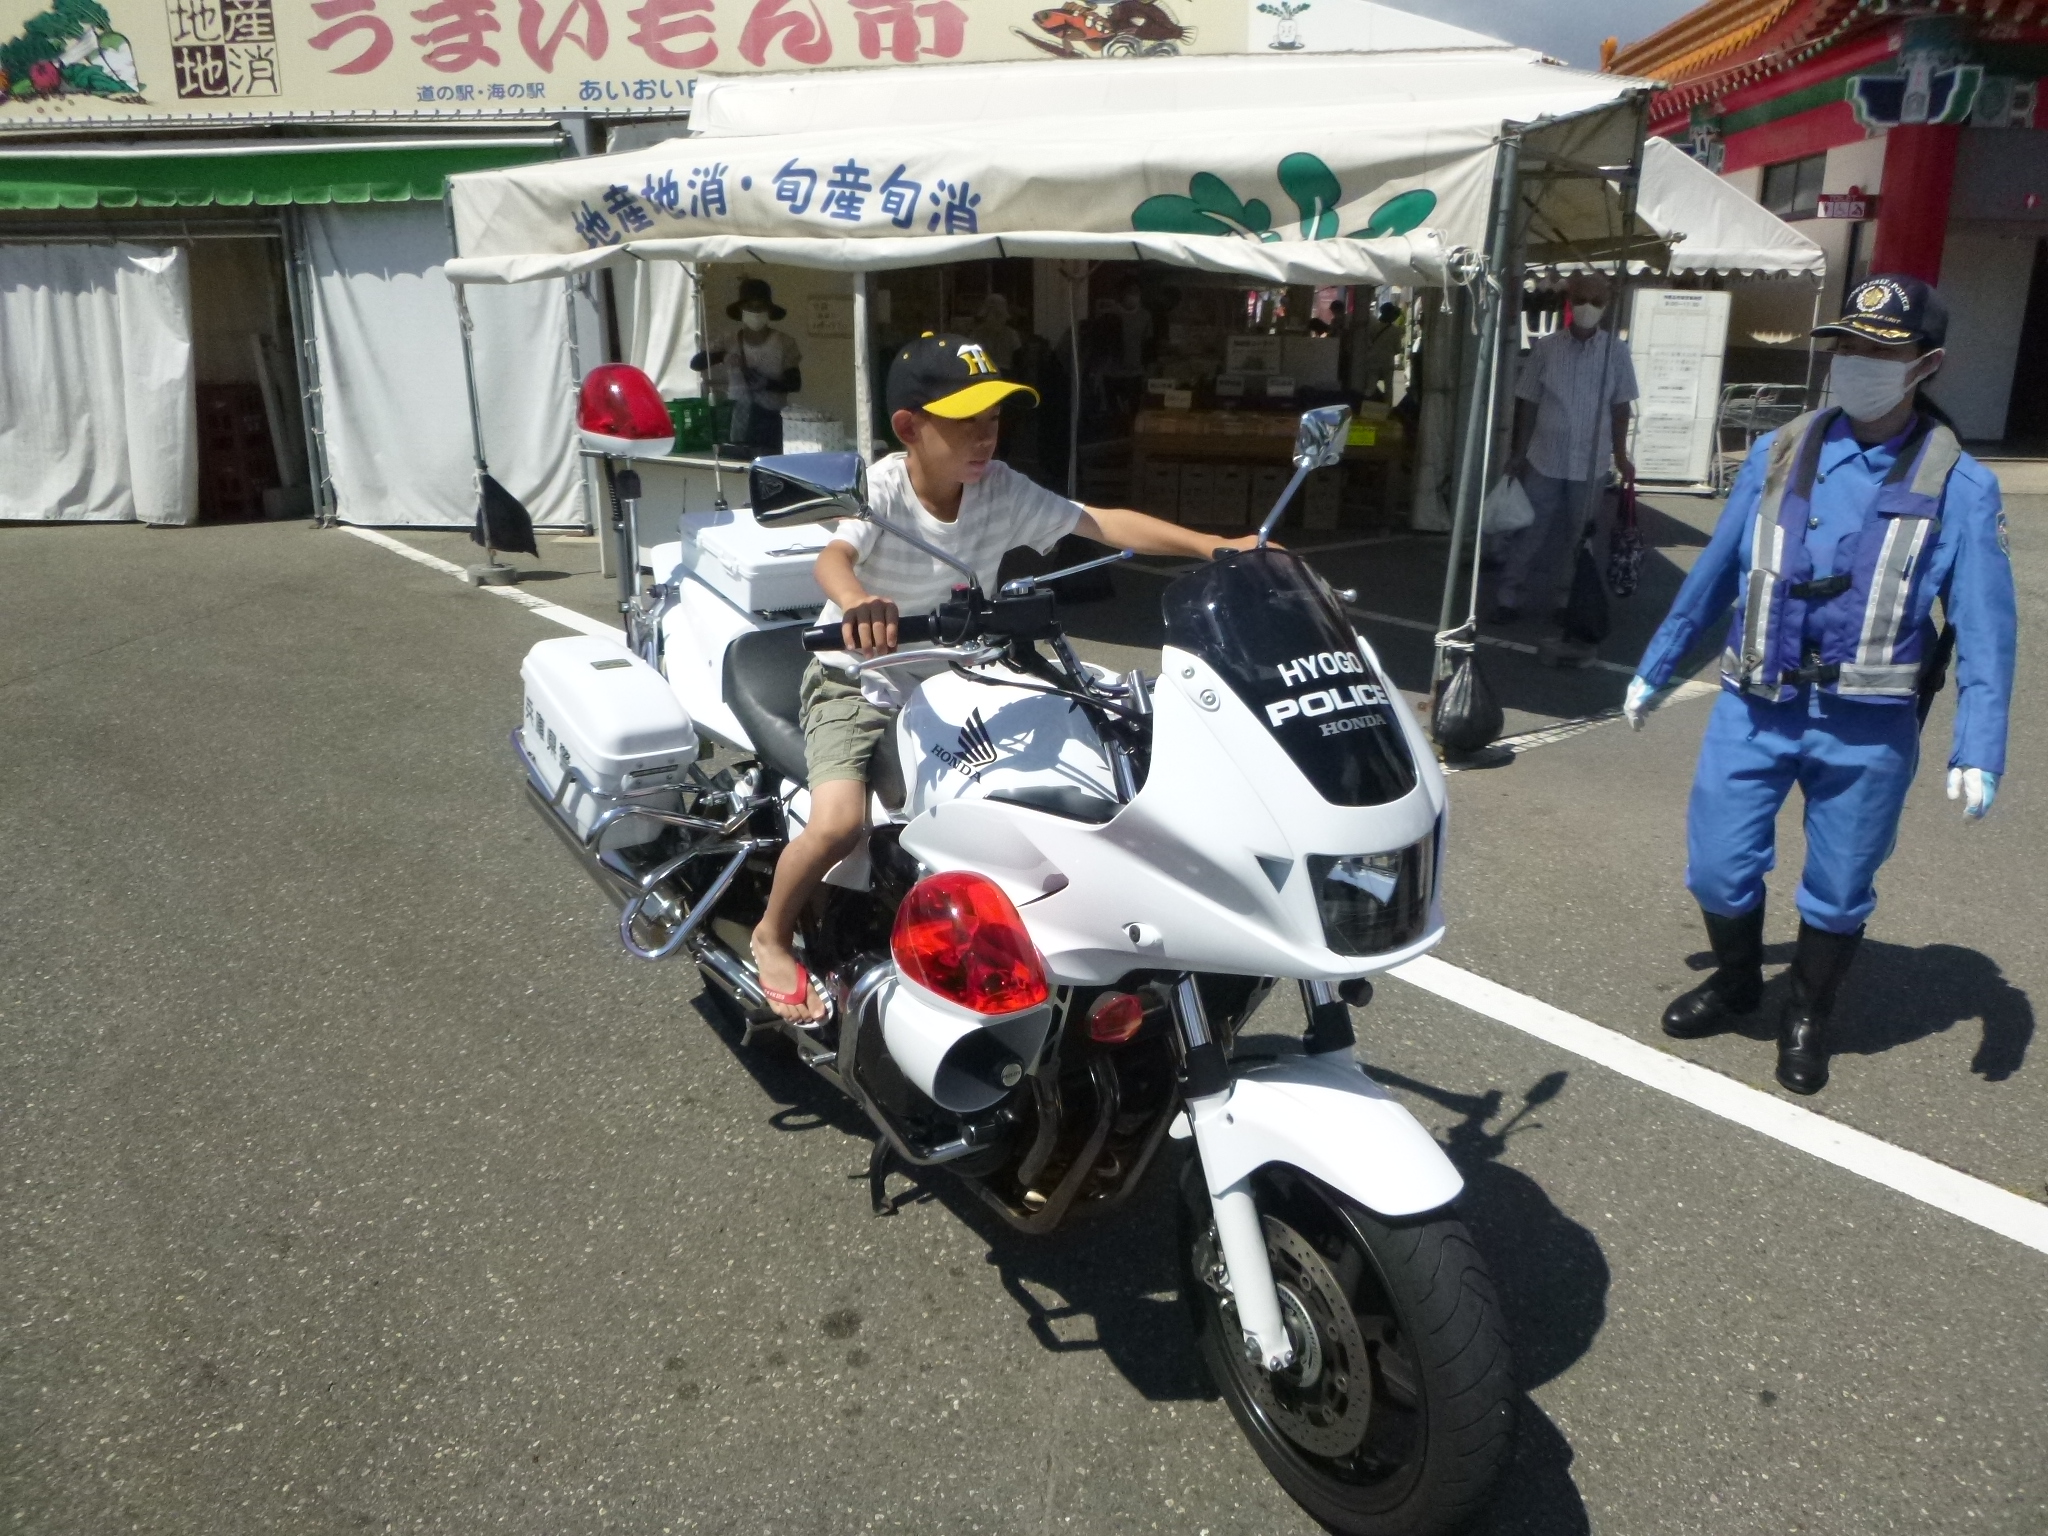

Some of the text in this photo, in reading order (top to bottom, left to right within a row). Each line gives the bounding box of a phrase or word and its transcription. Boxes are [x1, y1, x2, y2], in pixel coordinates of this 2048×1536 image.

[307, 0, 969, 74] うまいもん市
[416, 82, 545, 102] 道の駅・海の駅
[571, 158, 981, 249] 地産地消・旬産旬消
[1891, 282, 1910, 312] POLICE
[1277, 651, 1364, 687] HYOGO
[1265, 684, 1392, 727] POLICE
[1319, 713, 1386, 737] HONDA
[931, 743, 981, 784] HONDA
